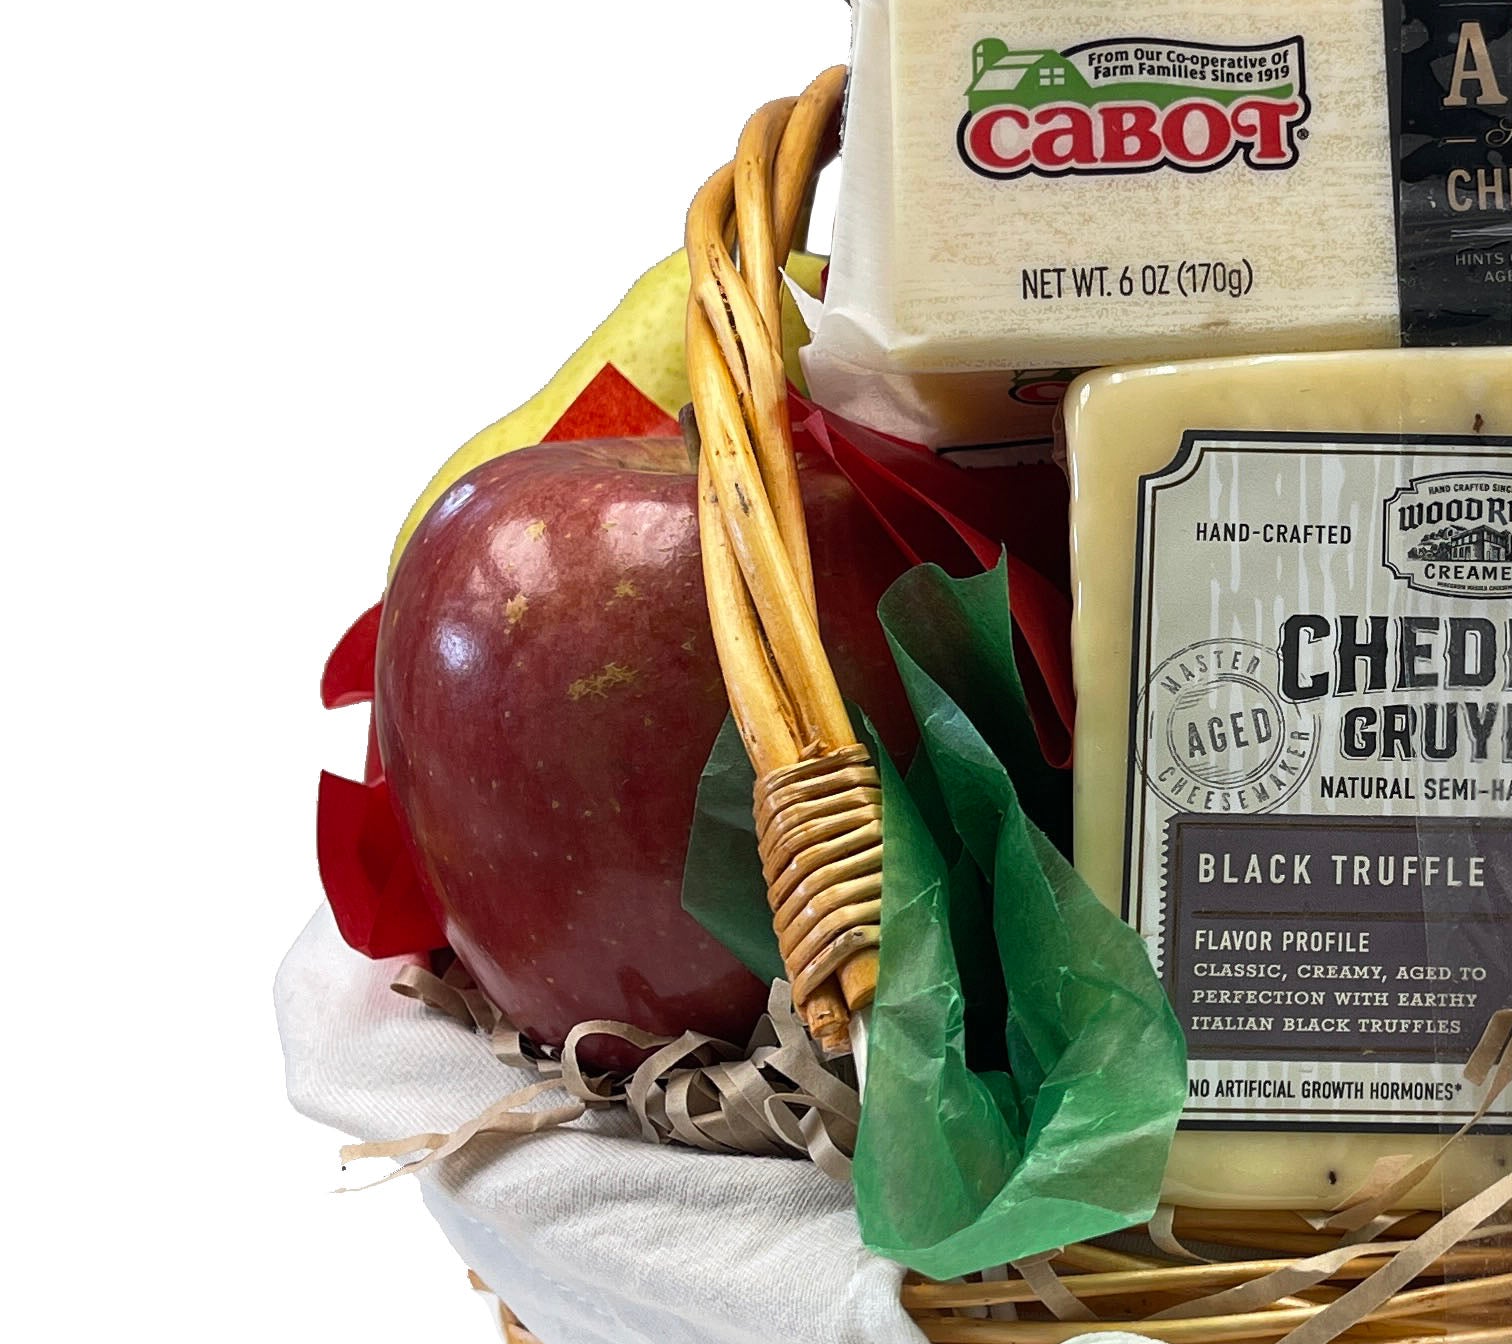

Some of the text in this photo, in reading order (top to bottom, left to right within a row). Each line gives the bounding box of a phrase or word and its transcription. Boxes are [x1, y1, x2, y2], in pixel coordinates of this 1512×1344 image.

[1088, 48, 1289, 69] From Our Co-operative Of
[1094, 62, 1290, 83] Farm Families Since 1919
[1455, 252, 1504, 266] HINTS
[1022, 258, 1253, 300] NET WT. 6 OZ (170g)
[1453, 483, 1490, 493] CRAFTED
[1196, 522, 1352, 544] HAND-CRAFTED
[1161, 650, 1260, 695] MASTER
[1187, 708, 1272, 758] AGED
[1158, 730, 1310, 811] CHEESEMAKER
[1320, 776, 1416, 800] NATURAL
[1198, 853, 1486, 887] BLACK TRUFFLE
[1194, 930, 1370, 953] FLAVOR PROFILE
[1193, 962, 1487, 983] CLASSIC, CREAMY, AGED TO
[1192, 989, 1478, 1008] PERFECTION WITH EARTHY
[1191, 1016, 1461, 1034] ITALIAN BLACK TRUFFLES
[1189, 1078, 1210, 1098] NO
[1214, 1079, 1296, 1099] ARTIFICIAL
[1301, 1081, 1364, 1100] GROWTH
